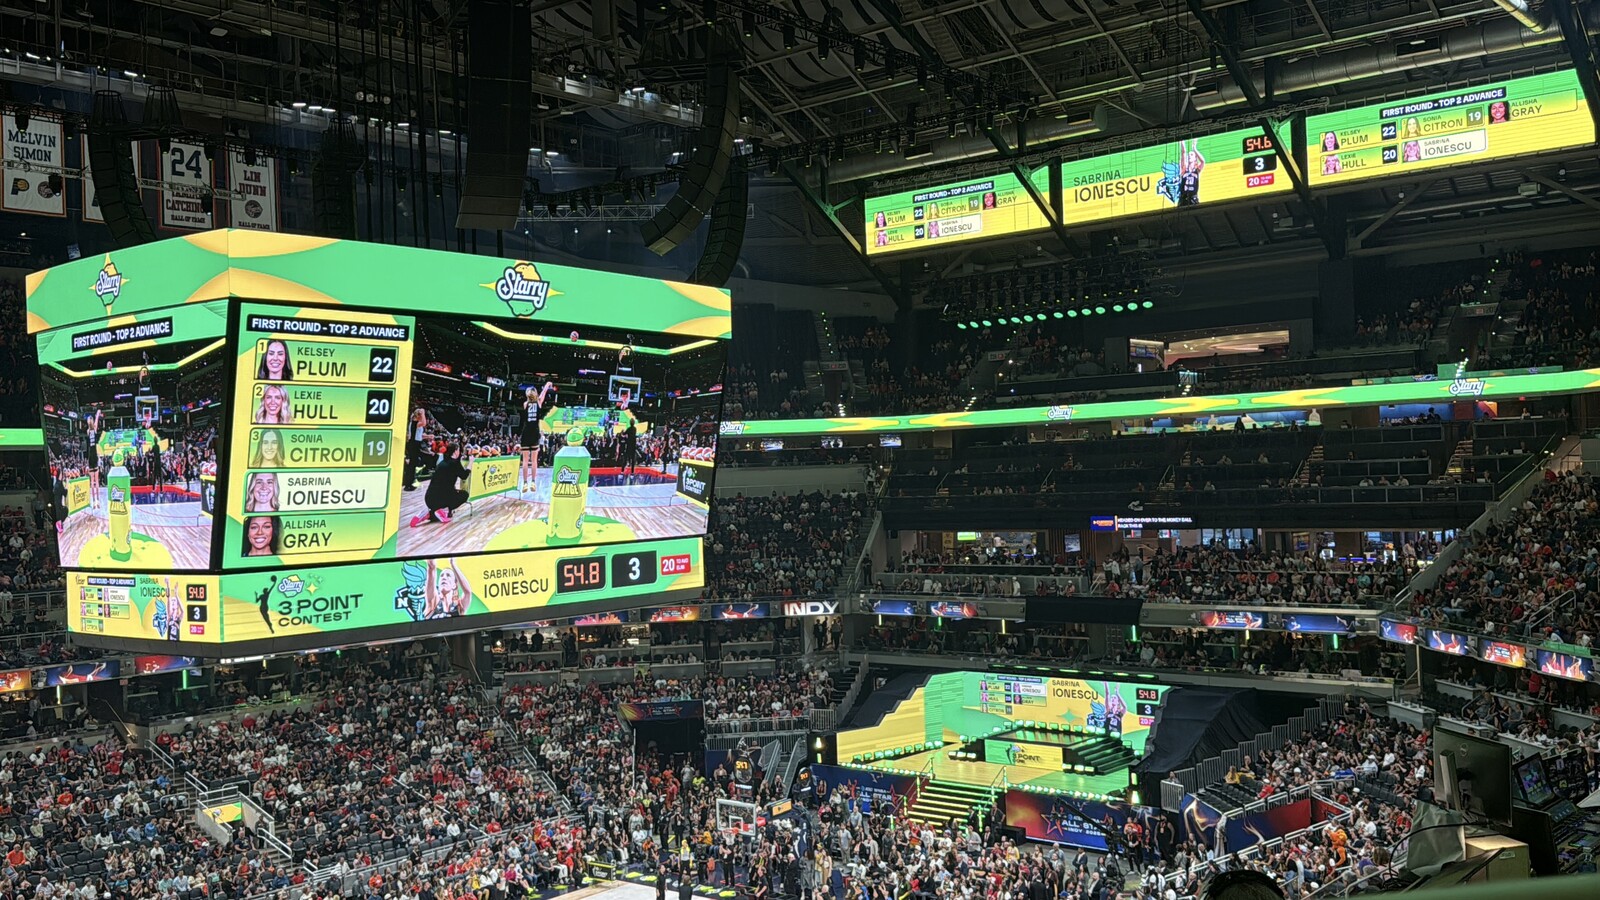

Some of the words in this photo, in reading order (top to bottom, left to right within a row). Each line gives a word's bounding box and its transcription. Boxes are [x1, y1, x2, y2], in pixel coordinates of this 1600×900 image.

[1383, 107, 1404, 117] FIRST
[1405, 102, 1433, 113] ROUND
[1439, 98, 1455, 107] TOP
[1463, 89, 1503, 103] ADVANCE
[1512, 99, 1538, 107] ALLISHA
[1468, 112, 1482, 122] 19
[1512, 105, 1542, 118] GRAY
[1383, 126, 1395, 136] 22
[1424, 118, 1463, 132] CITRON
[8, 129, 56, 147] MELVIN
[1341, 135, 1368, 146] PLUM
[1424, 138, 1449, 146] SABRINA
[14, 146, 52, 162] SIMON
[1384, 150, 1396, 160] 20
[1425, 141, 1472, 156] IONESCU
[171, 147, 202, 179] 24
[236, 152, 267, 167] COCH
[1255, 157, 1264, 170] 3
[1342, 159, 1366, 169] HULL
[244, 170, 261, 182] LIN
[1074, 170, 1121, 187] SABRINA
[1249, 177, 1260, 186] 20
[239, 183, 266, 196] DUNN
[929, 190, 947, 199] ROUND
[967, 182, 992, 192] ADVANCE
[1074, 177, 1150, 203] IONESCU
[970, 200, 978, 208] 19
[998, 196, 1017, 205] GRAY
[942, 205, 966, 215] CITRON
[942, 224, 972, 234] IONESCU
[96, 270, 122, 296] Starry
[497, 268, 549, 310] Starry
[252, 318, 282, 330] FIRST
[284, 321, 321, 332] ROUND
[329, 324, 349, 334] TOP
[351, 325, 357, 335] 2
[359, 327, 404, 338] ADVANCE
[74, 337, 89, 348] FIRST
[91, 332, 111, 345] ROUND
[116, 329, 129, 340] TOP
[130, 328, 134, 338] 2
[136, 322, 169, 337] ADVANCE
[259, 342, 264, 351] 1
[297, 347, 335, 357] KELSEY
[296, 360, 346, 377] PLUM
[372, 357, 392, 373] 22
[256, 387, 262, 396] 2
[1450, 379, 1484, 395] Starry
[294, 391, 322, 400] LEXIE
[293, 404, 338, 420] HULL
[368, 399, 389, 415] 20
[528, 403, 537, 412] 20
[1048, 406, 1072, 420] Starry
[720, 422, 745, 434] Starry
[253, 431, 259, 441] 3
[291, 434, 323, 443] SONIA
[290, 447, 357, 462] CITRON
[366, 440, 386, 456] 19
[288, 477, 331, 487] SABRINA
[493, 472, 512, 480] POINT
[287, 489, 366, 506] IONESCU
[284, 520, 326, 530] ALLISHA
[283, 532, 332, 549] GRAY
[628, 557, 640, 580] 3
[663, 559, 675, 572] 20
[483, 567, 524, 580] SABRINA
[564, 562, 600, 587] 54.8
[279, 578, 305, 593] Starry
[484, 578, 549, 599] IONESCU
[141, 587, 170, 598] IONESCU
[189, 587, 204, 598] 54.8
[278, 601, 292, 615] 3
[297, 594, 363, 614] POINT
[784, 601, 840, 616] INDY
[194, 607, 200, 620] 3
[278, 611, 352, 627] CONTEST
[1053, 688, 1099, 700] IONESCU
[1139, 690, 1156, 699] 54.8
[1144, 705, 1152, 714] 3
